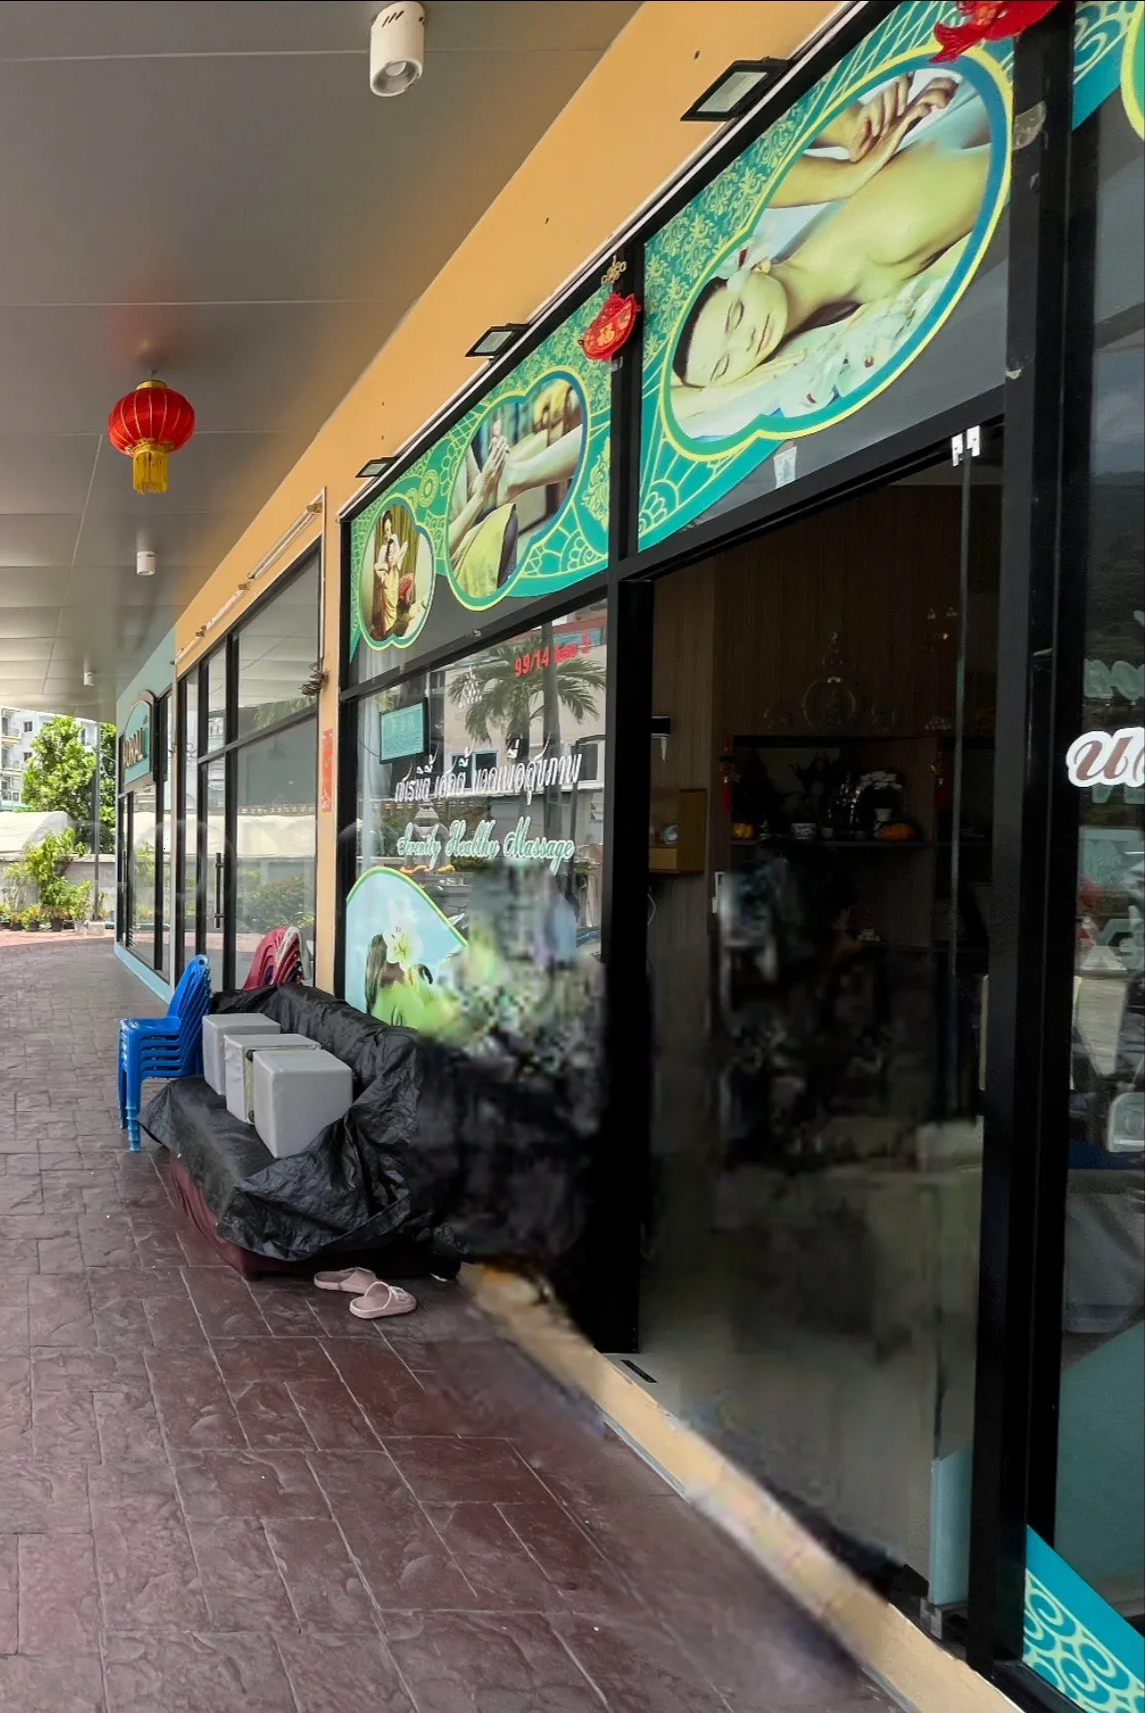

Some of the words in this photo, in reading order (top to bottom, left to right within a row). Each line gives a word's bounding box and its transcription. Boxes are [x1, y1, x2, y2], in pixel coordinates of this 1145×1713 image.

[514, 645, 550, 678] 99/14
[445, 819, 500, 860] Healthy
[503, 815, 575, 875] Massage
